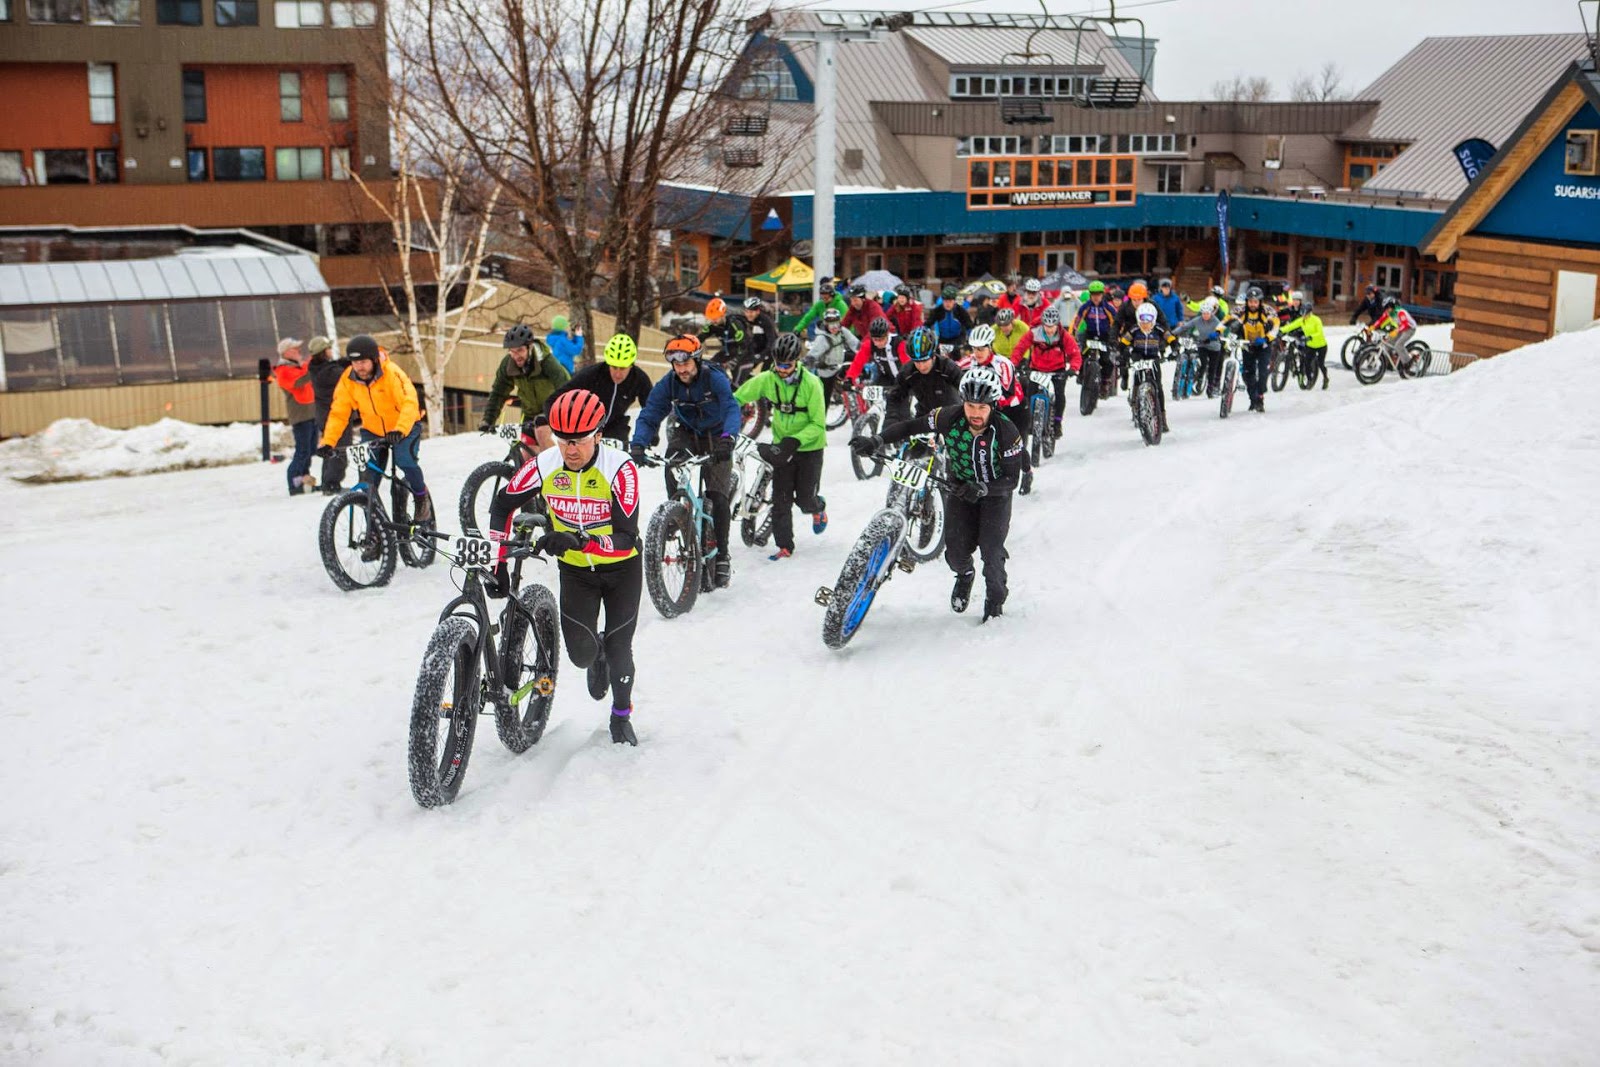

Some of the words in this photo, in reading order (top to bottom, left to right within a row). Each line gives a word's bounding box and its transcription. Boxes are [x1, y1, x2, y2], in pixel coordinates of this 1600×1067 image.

[1014, 191, 1092, 204] WIDOWMAKER
[621, 463, 634, 505] HAMMER
[549, 497, 610, 515] HAMMER
[456, 537, 491, 567] 383
